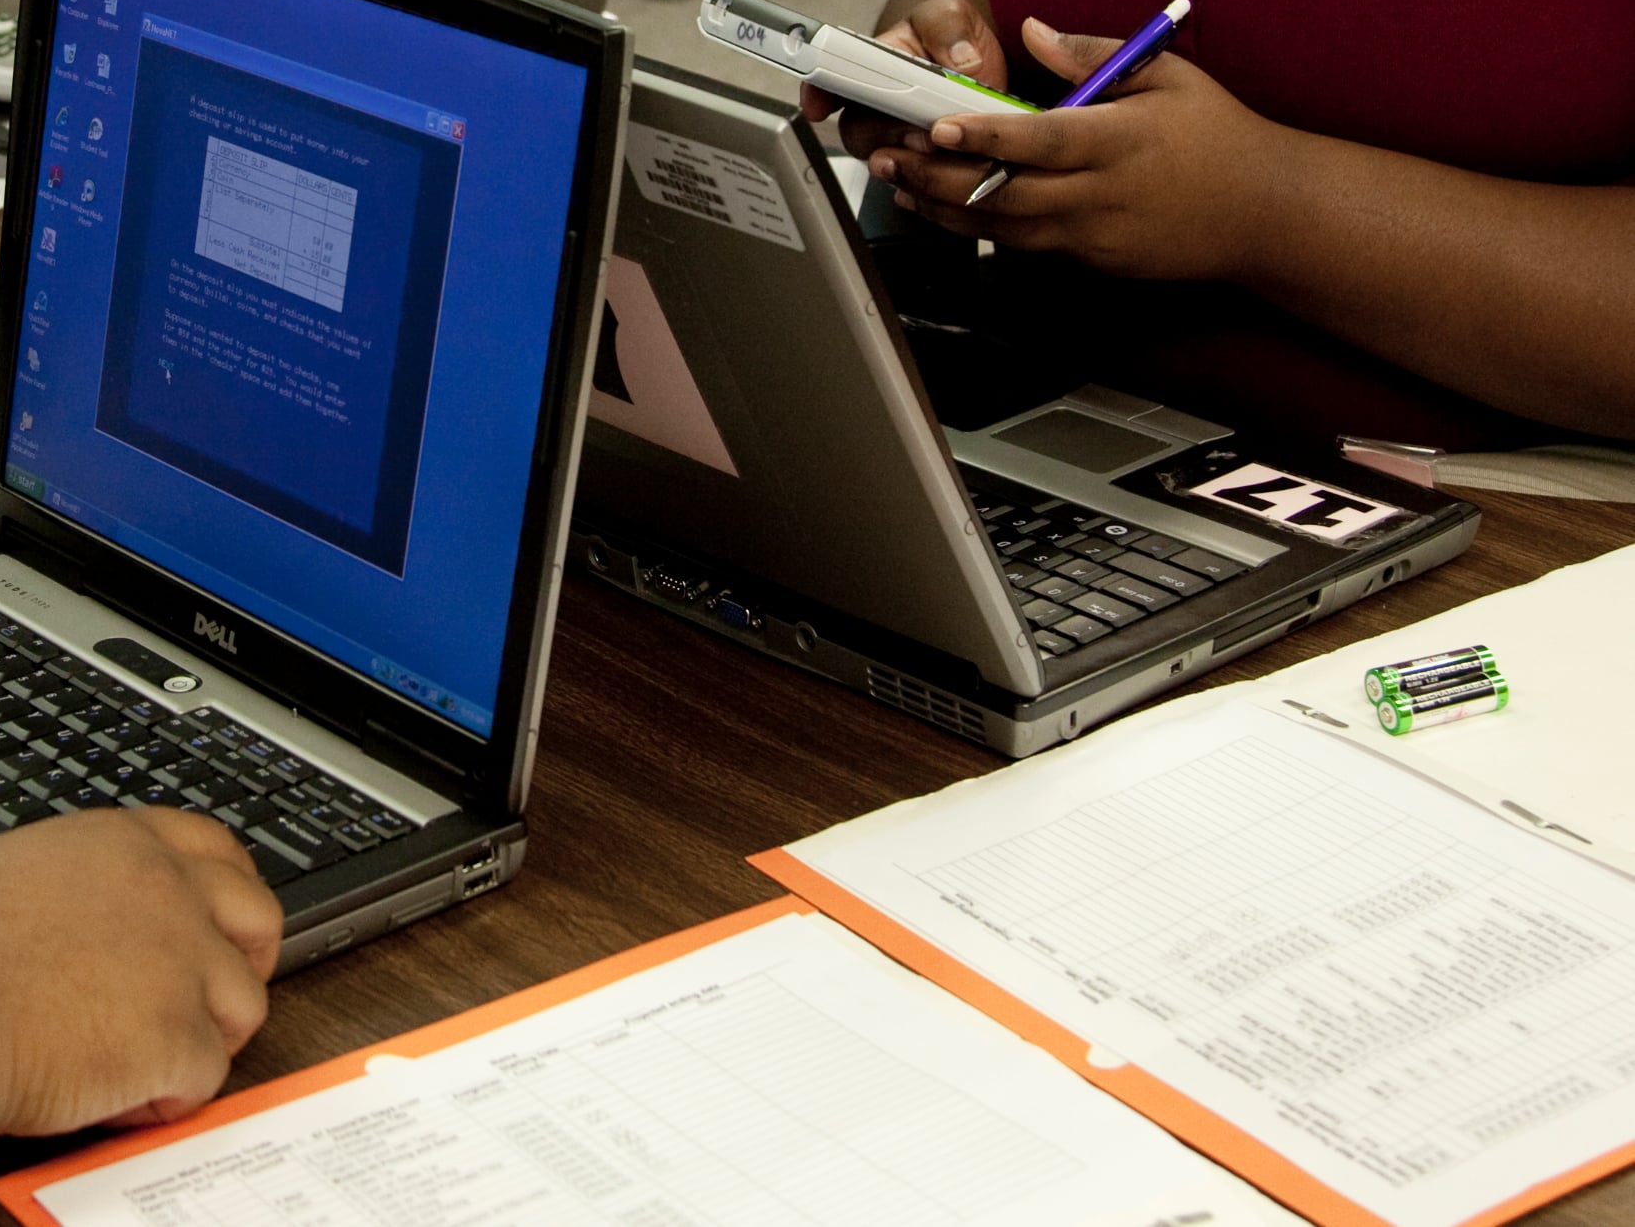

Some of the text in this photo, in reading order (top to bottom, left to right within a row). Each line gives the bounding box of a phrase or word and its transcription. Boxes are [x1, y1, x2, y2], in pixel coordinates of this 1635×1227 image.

[18, 475, 35, 491] start
[1212, 476, 1377, 529] 17
[194, 612, 237, 654] DELL
